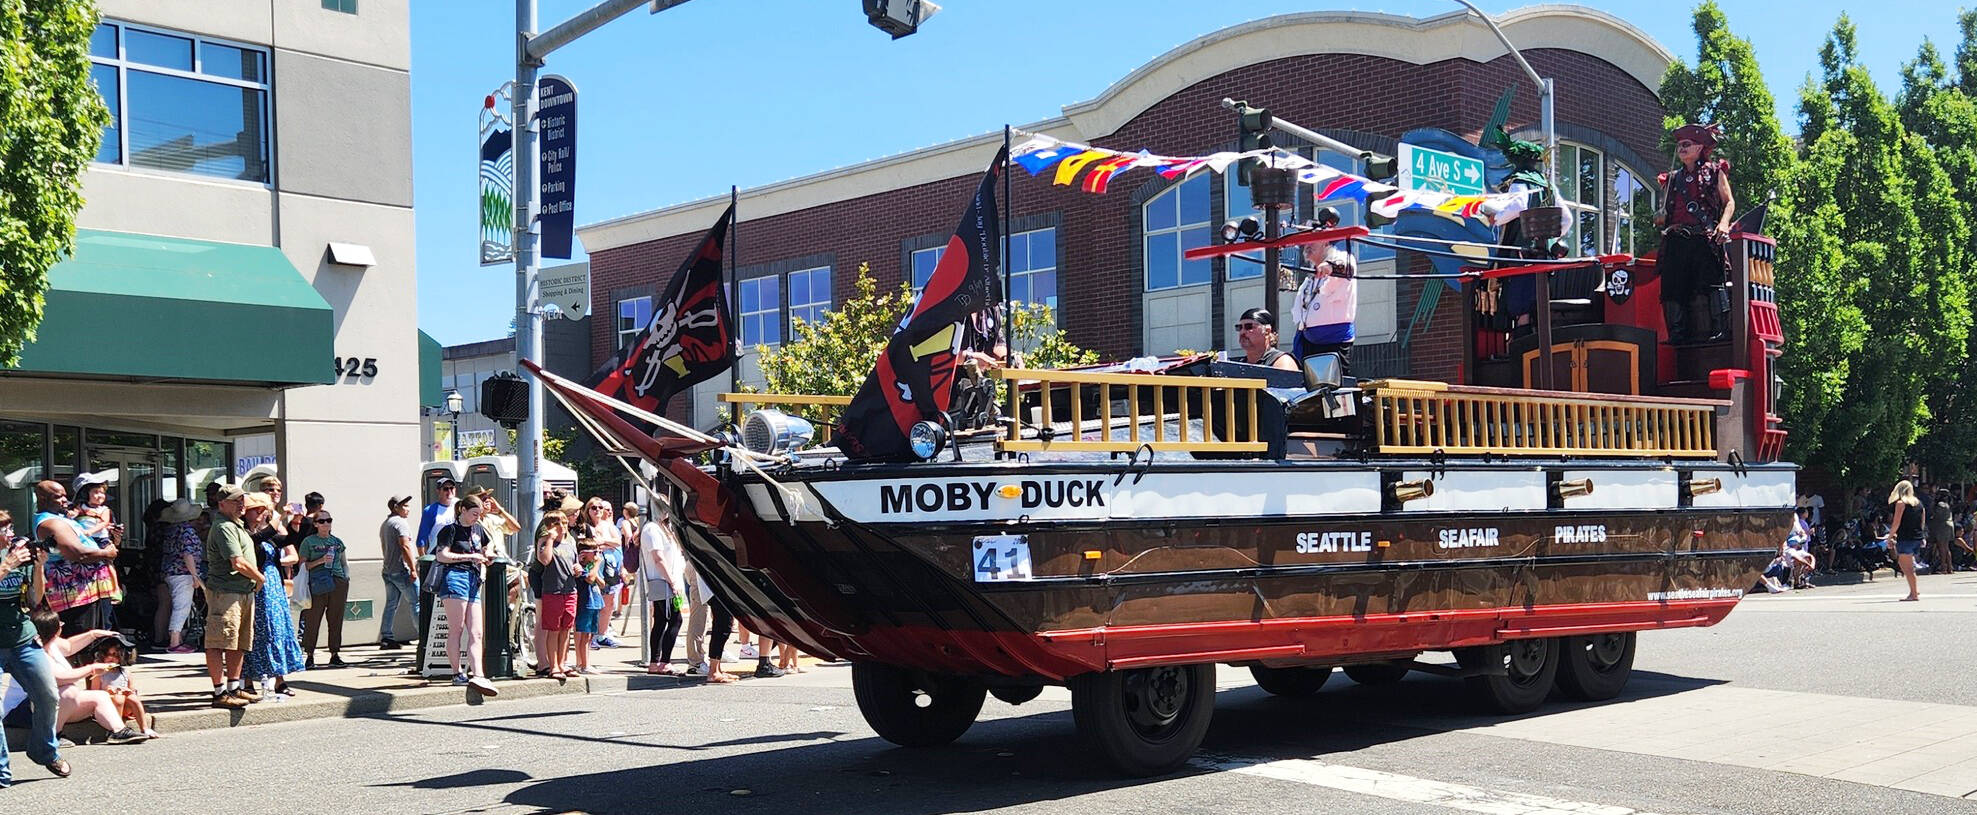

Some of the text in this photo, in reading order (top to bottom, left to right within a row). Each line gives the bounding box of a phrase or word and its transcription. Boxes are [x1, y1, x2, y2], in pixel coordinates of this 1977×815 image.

[540, 85, 554, 98] KENT
[540, 92, 573, 110] DOWNTOWN
[547, 114, 566, 128] Historic
[547, 127, 565, 141] District
[547, 150, 557, 163] City
[547, 162, 562, 174] Police
[1416, 152, 1460, 181] 4 Ave S
[547, 180, 565, 194] Parking
[548, 200, 572, 215] Post Office
[541, 274, 586, 287] HISTORIC DISTRICT
[543, 290, 563, 298] Shopping
[457, 432, 494, 447] ATTOO
[880, 480, 1105, 514] MOBY DUCK
[1296, 525, 1607, 553] SEATTLE SEAFAIR PIRATES
[977, 548, 1026, 580] 41
[1647, 588, 1743, 600] www.seattleseafairpirates.org
